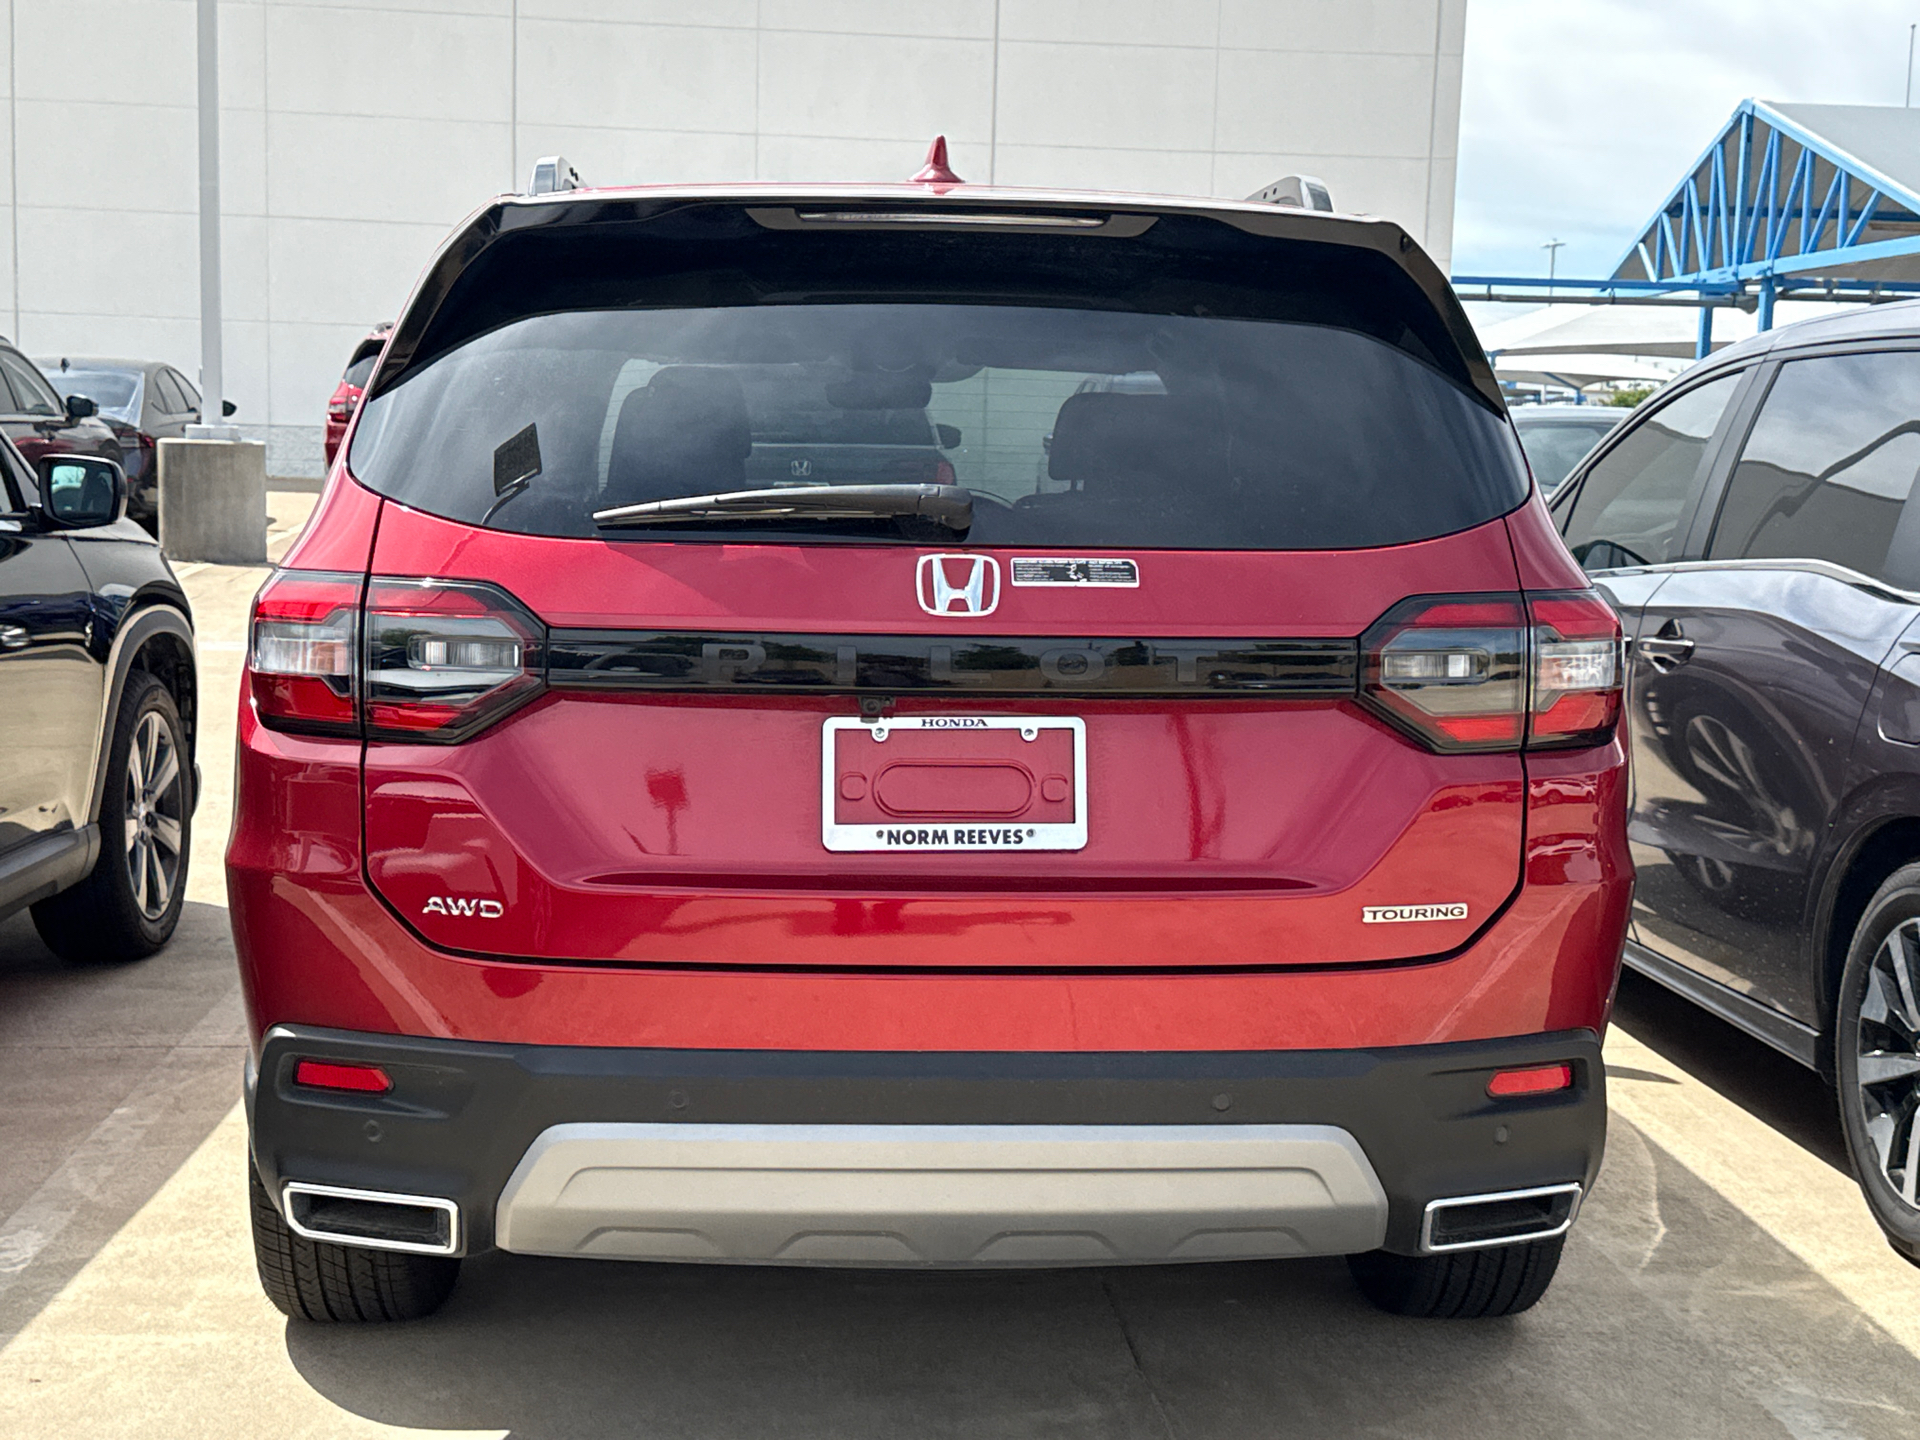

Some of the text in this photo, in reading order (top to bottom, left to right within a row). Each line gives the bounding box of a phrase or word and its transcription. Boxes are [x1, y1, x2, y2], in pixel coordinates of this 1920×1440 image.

[702, 643, 1219, 683] PILOT
[921, 718, 989, 728] HONDA
[887, 828, 1024, 845] NORM REEVES
[422, 896, 504, 918] AWD
[1366, 906, 1465, 921] TOURING
